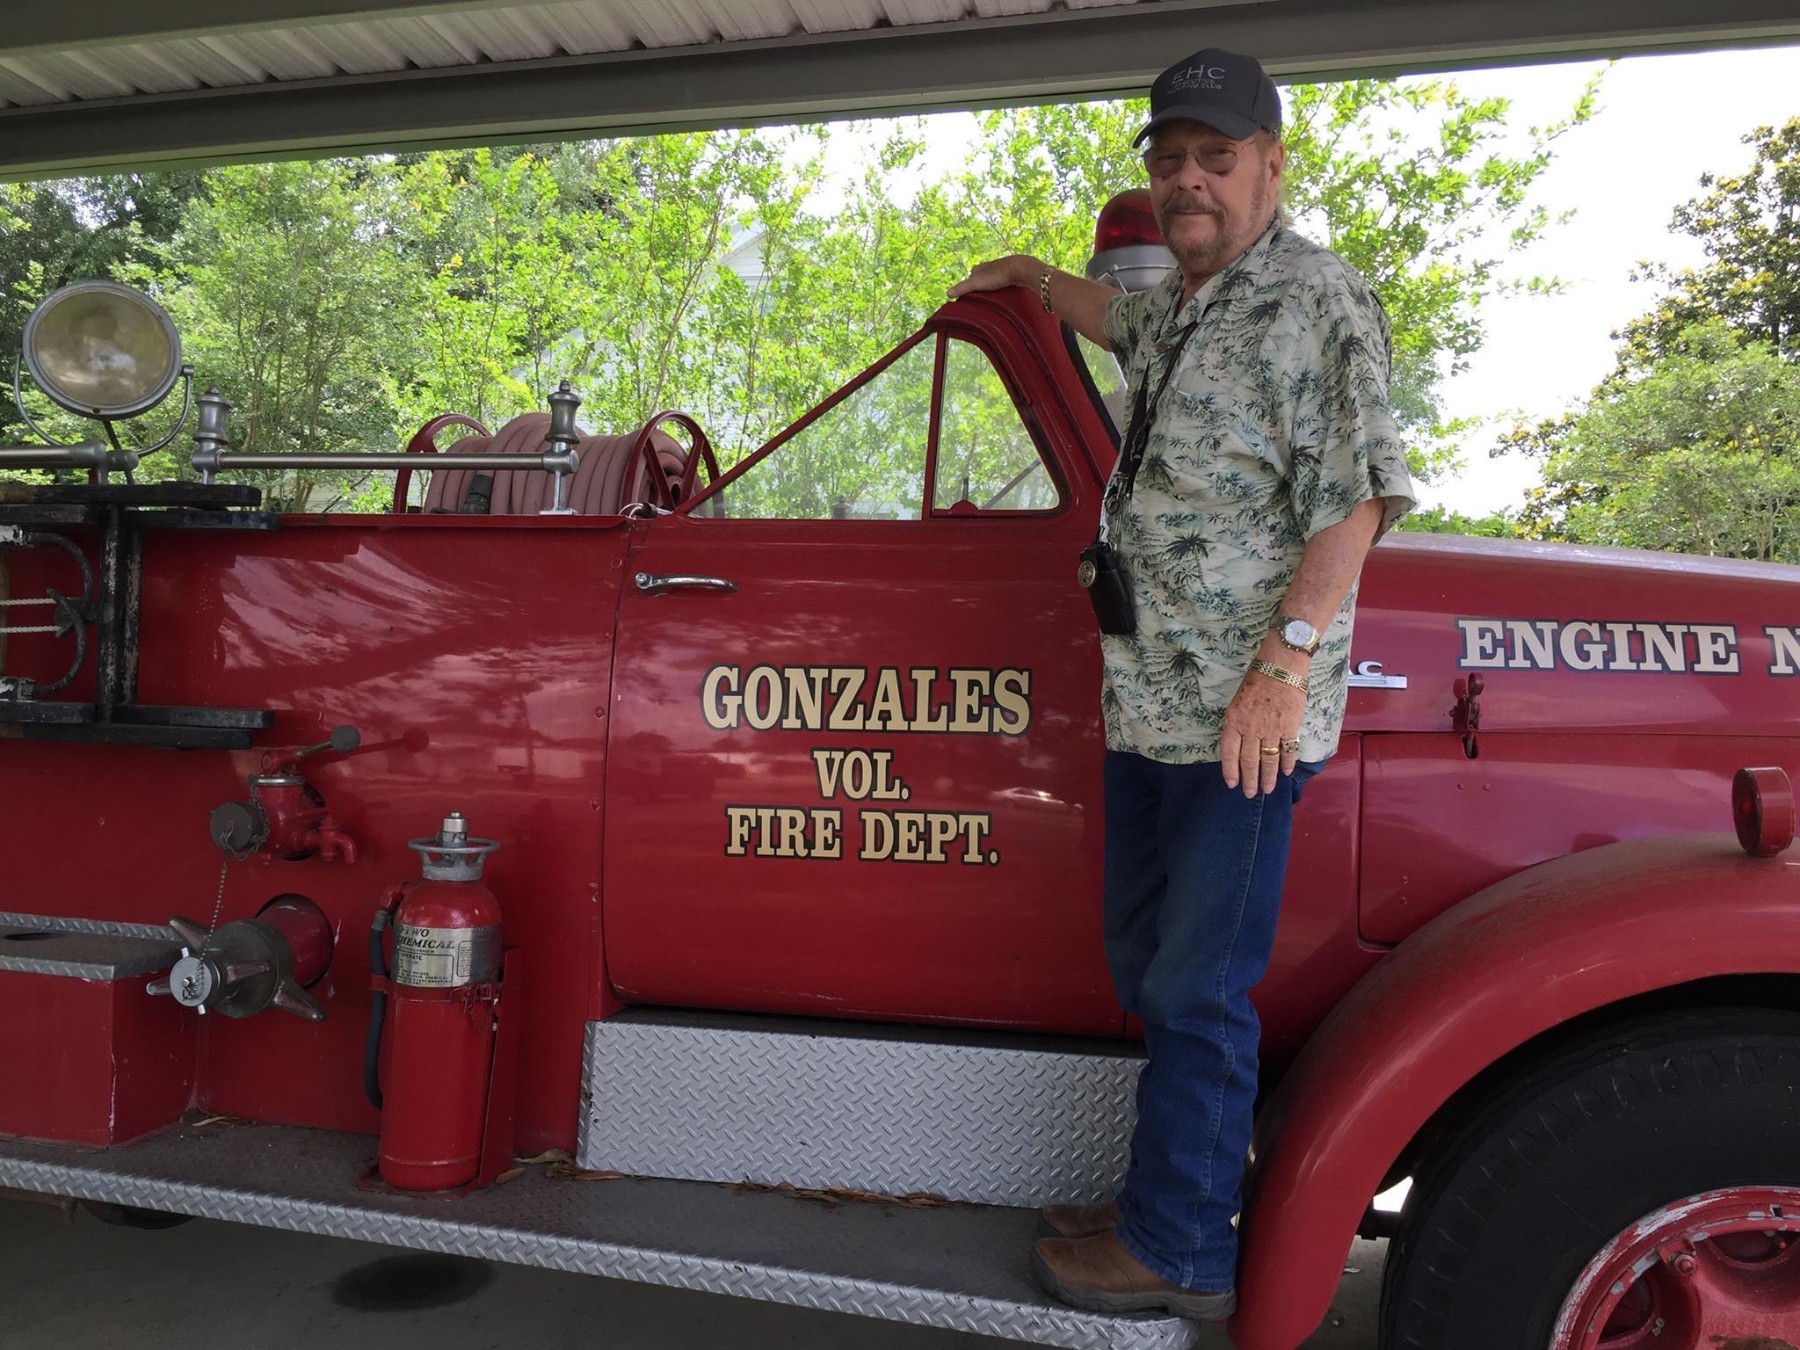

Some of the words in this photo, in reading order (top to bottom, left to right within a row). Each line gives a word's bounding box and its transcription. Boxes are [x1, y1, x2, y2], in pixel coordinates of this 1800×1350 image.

[1171, 65, 1226, 85] EHC
[1201, 82, 1222, 90] CLUB
[1458, 619, 1740, 673] ENGINE
[702, 665, 1031, 735] GONZALES
[812, 749, 910, 800] VOL.
[726, 806, 842, 858] FIRE
[860, 810, 1000, 865] DEPT.
[397, 935, 455, 949] CHEMICAL
